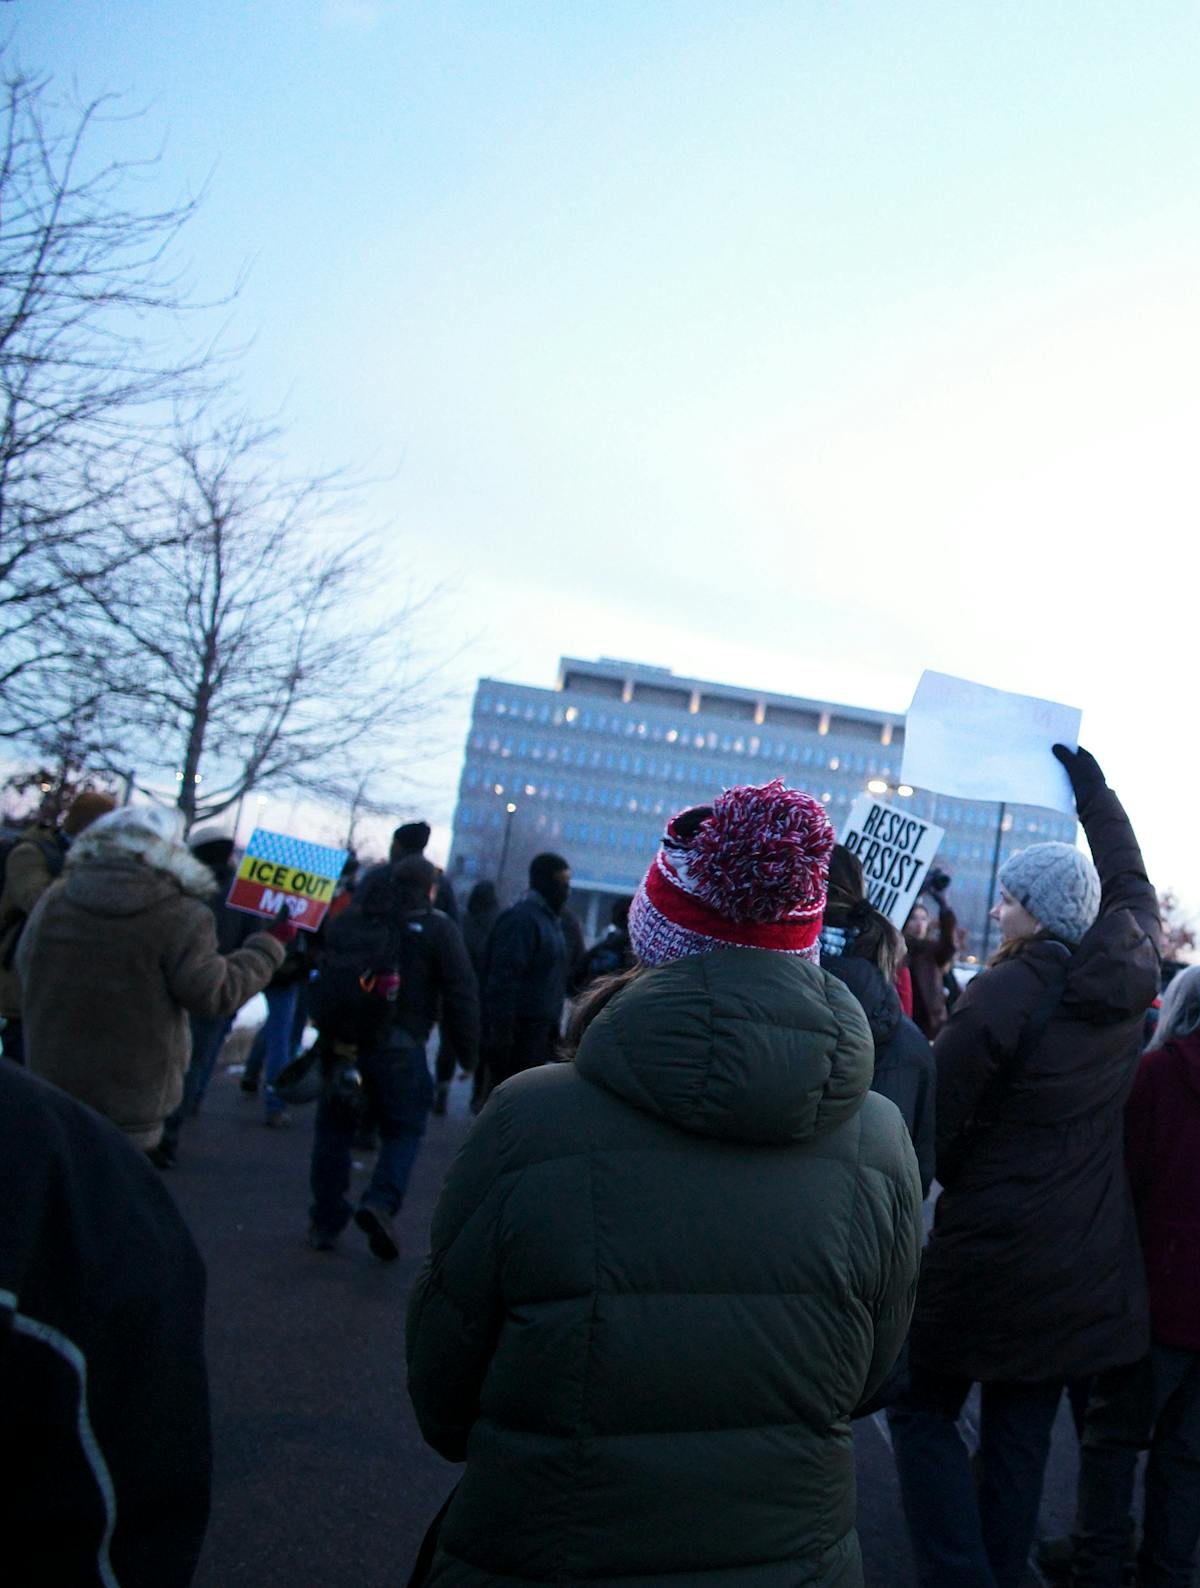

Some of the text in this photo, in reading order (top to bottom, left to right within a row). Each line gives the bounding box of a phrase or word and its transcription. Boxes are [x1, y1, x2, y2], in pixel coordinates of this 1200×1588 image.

[862, 804, 928, 854] RESIST
[248, 860, 331, 896] ICE OUT
[844, 830, 924, 893] PERSIST
